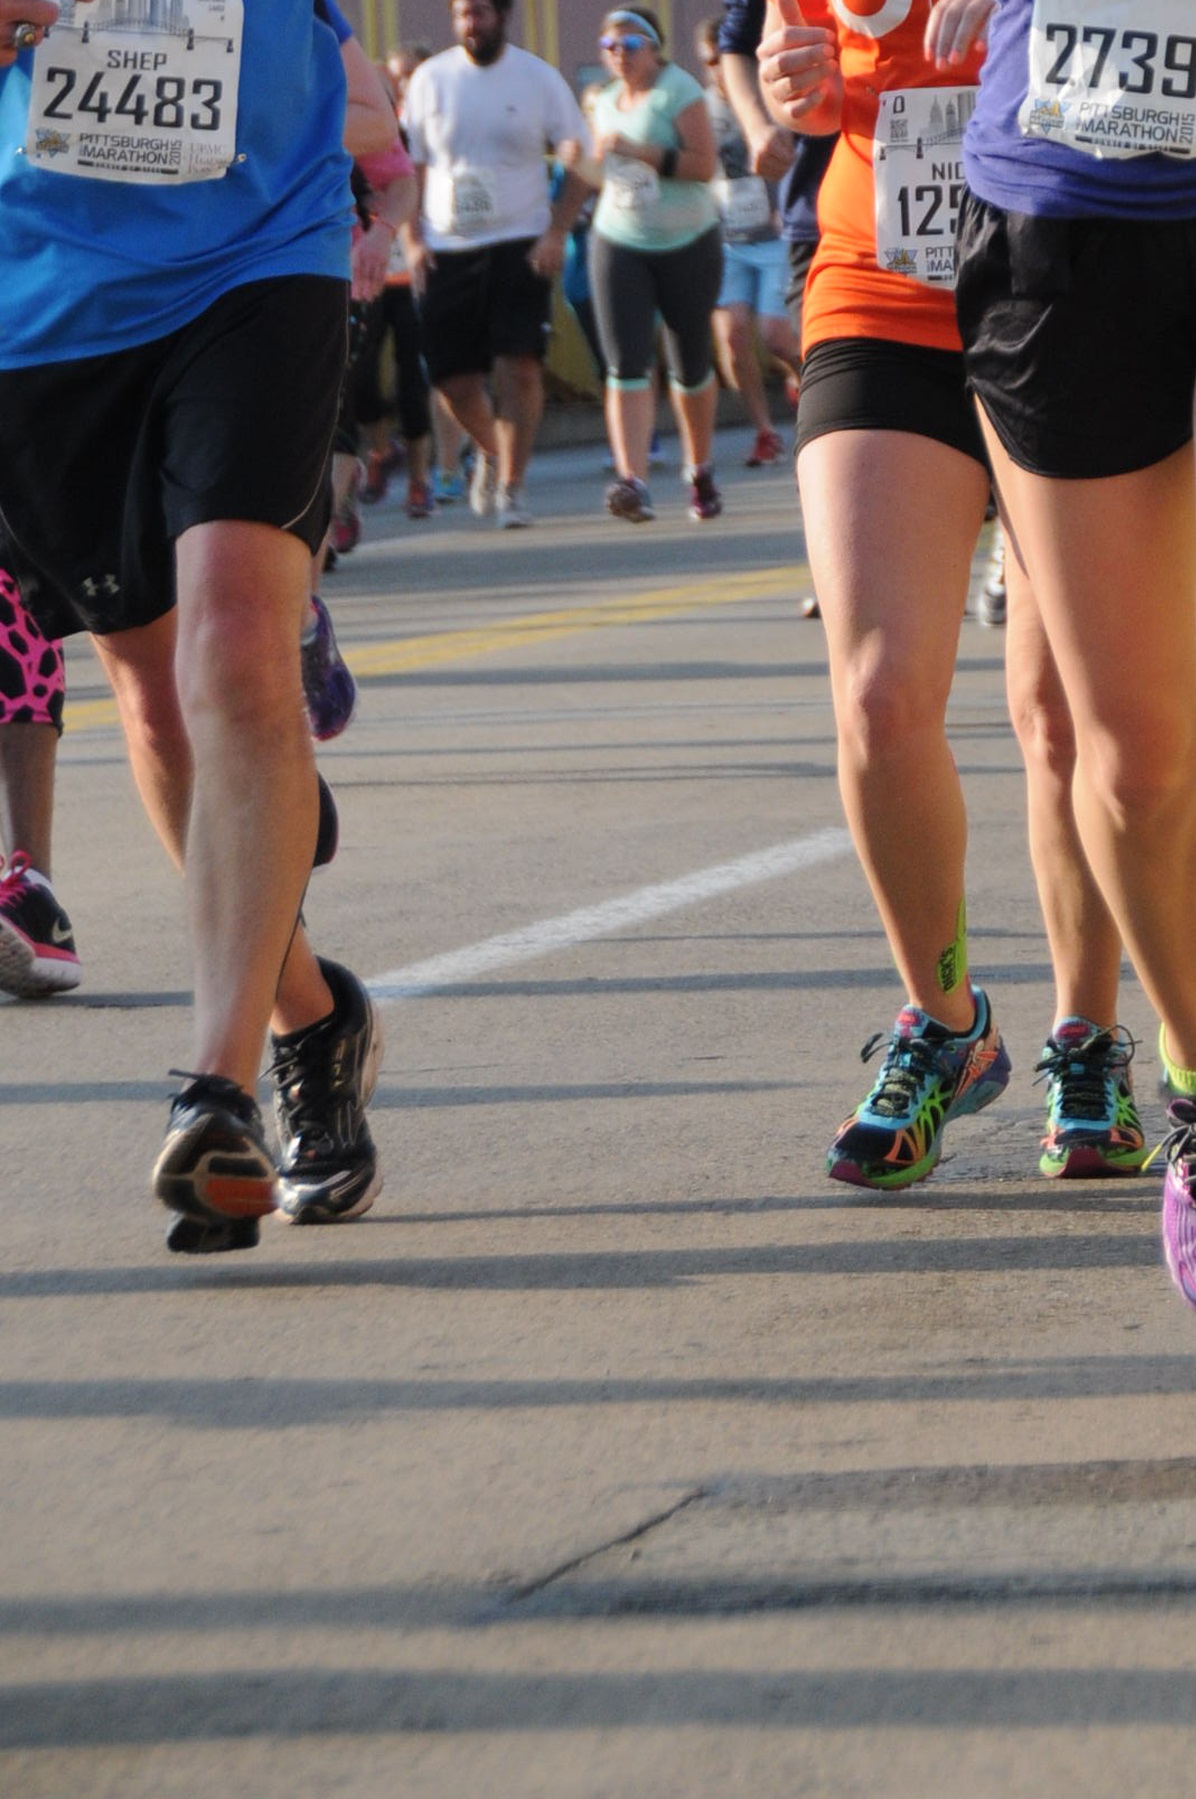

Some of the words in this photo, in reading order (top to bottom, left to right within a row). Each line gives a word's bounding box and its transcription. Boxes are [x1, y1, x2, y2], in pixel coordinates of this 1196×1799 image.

[106, 49, 167, 71] SHEP
[43, 67, 223, 132] 24483
[1080, 101, 1180, 126] PITTSBURGH
[1081, 119, 1178, 143] MARATHON
[1178, 113, 1196, 144] 2015
[79, 132, 170, 151] PITTSBURGH
[168, 139, 183, 165] 2015
[82, 144, 168, 165] MARATHON
